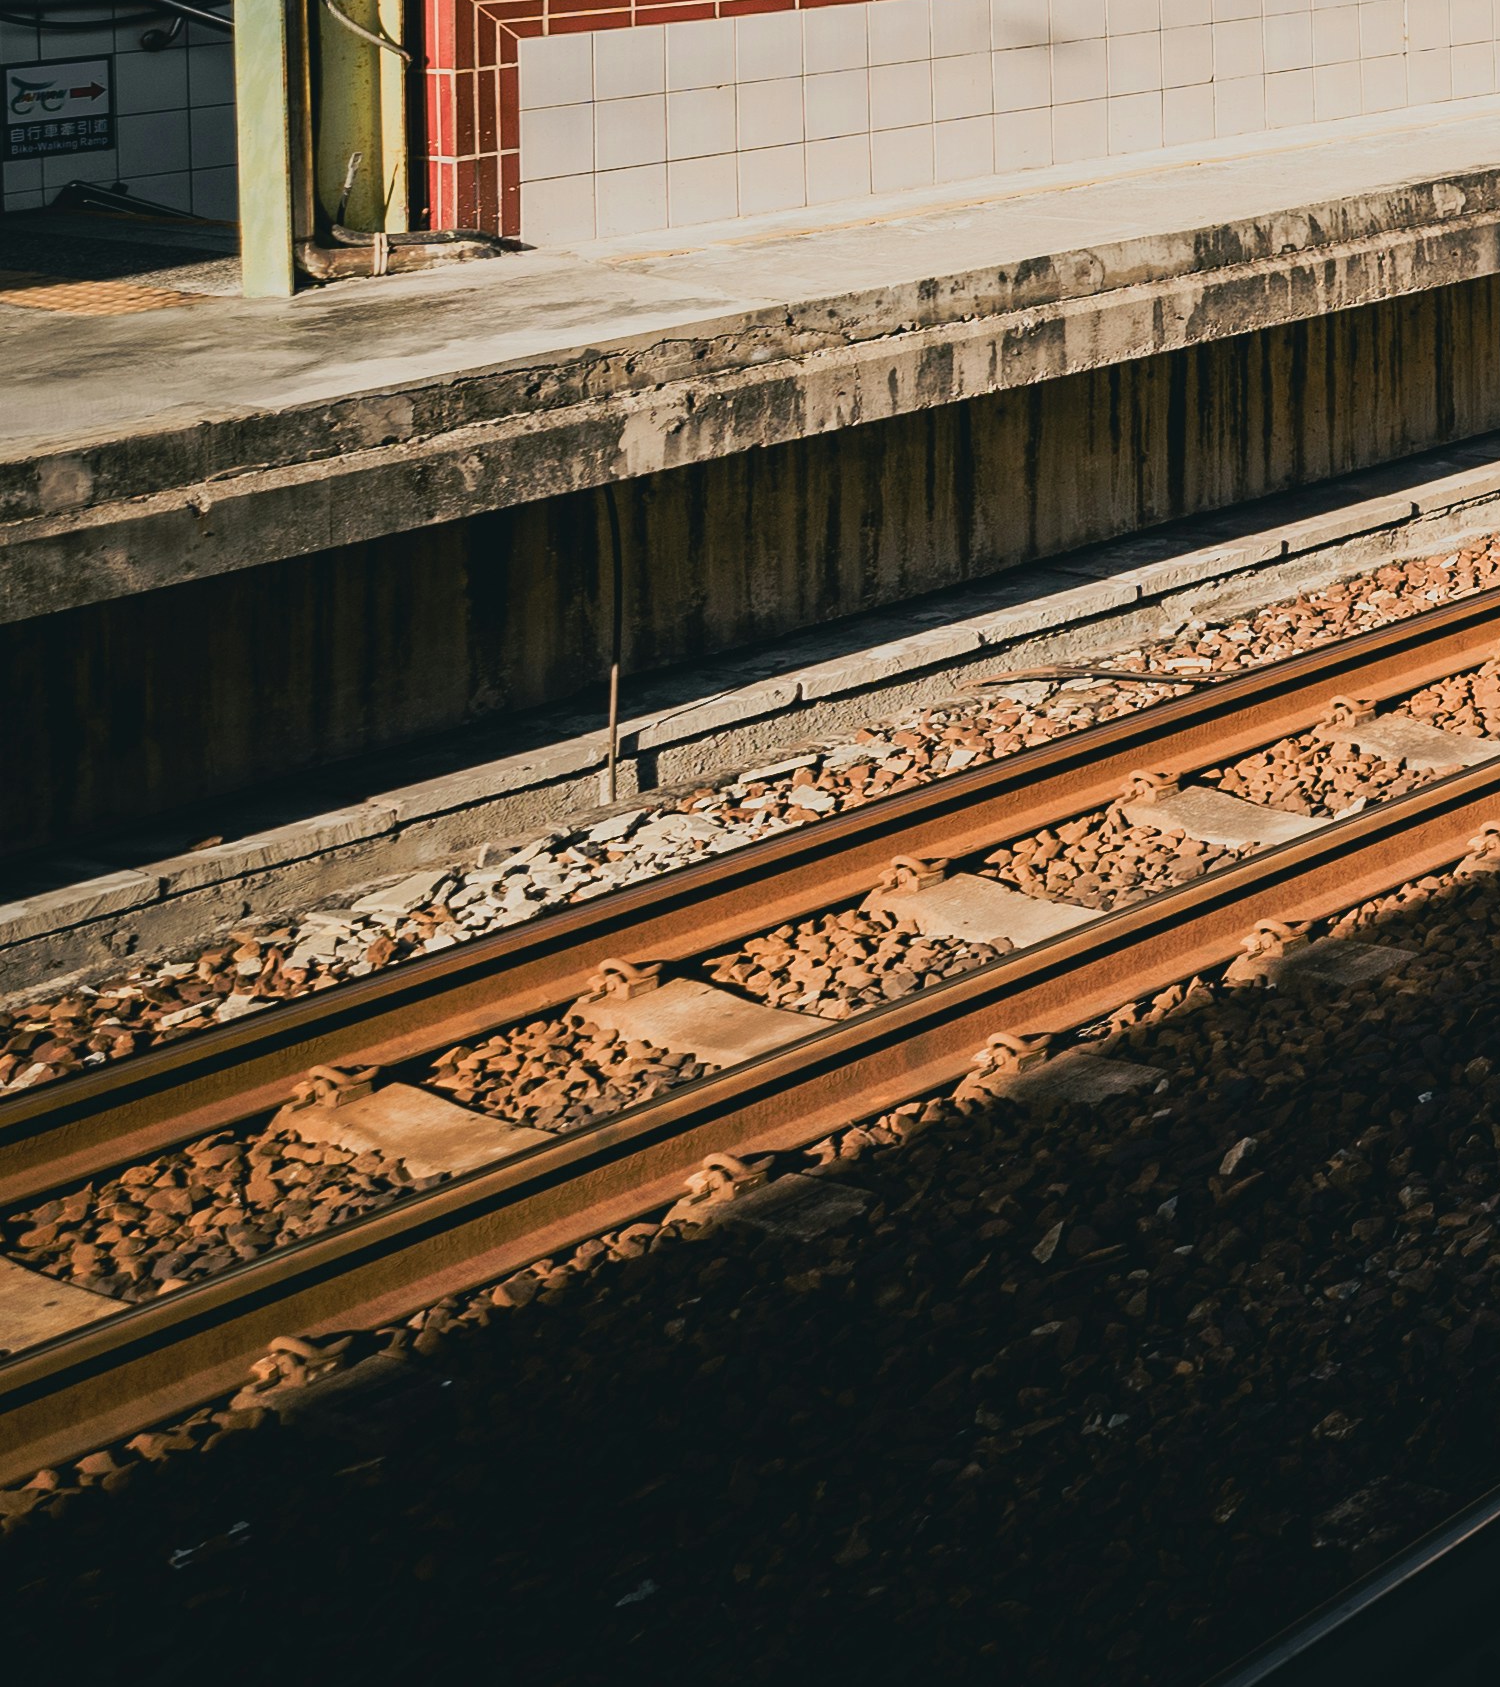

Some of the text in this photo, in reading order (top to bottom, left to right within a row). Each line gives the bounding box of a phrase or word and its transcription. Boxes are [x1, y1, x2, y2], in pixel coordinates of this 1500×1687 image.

[10, 118, 109, 143] 自行車牽引道
[80, 137, 109, 147] Ramp
